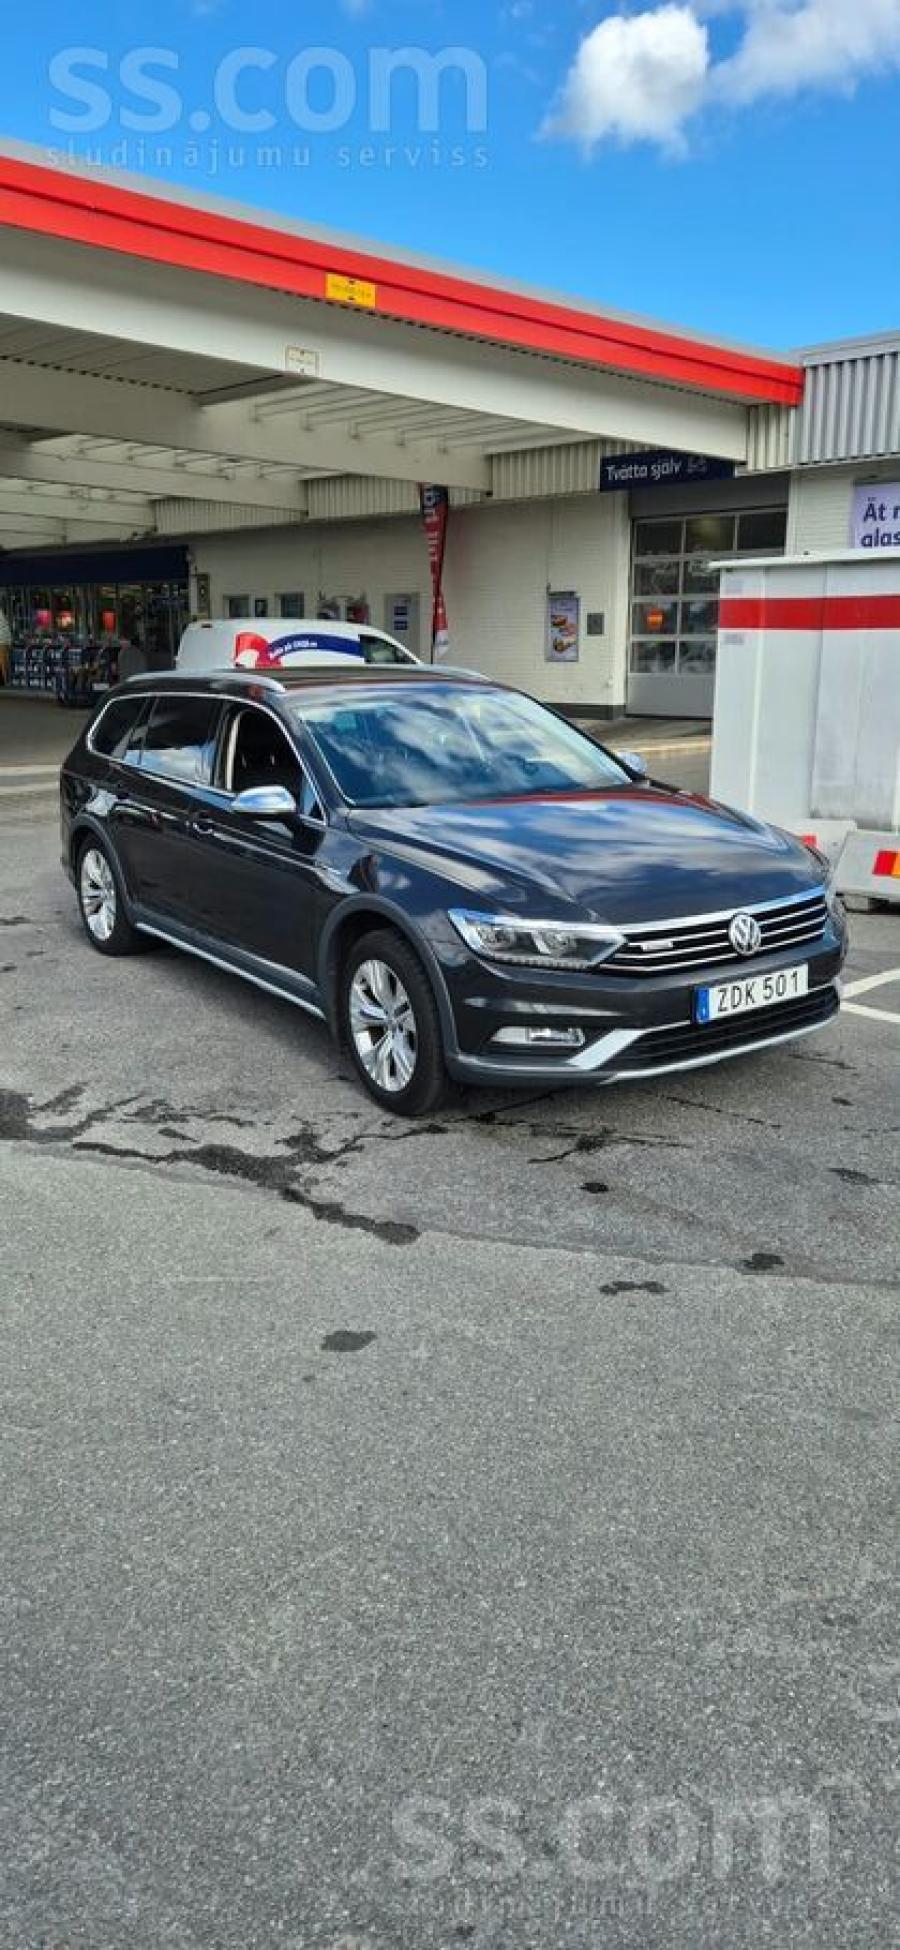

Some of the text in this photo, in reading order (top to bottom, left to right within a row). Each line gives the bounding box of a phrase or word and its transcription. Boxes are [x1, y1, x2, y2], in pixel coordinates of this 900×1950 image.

[606, 456, 681, 481] Tvätta själv
[863, 496, 887, 522] Ät
[718, 970, 798, 1012] ZDK 501
